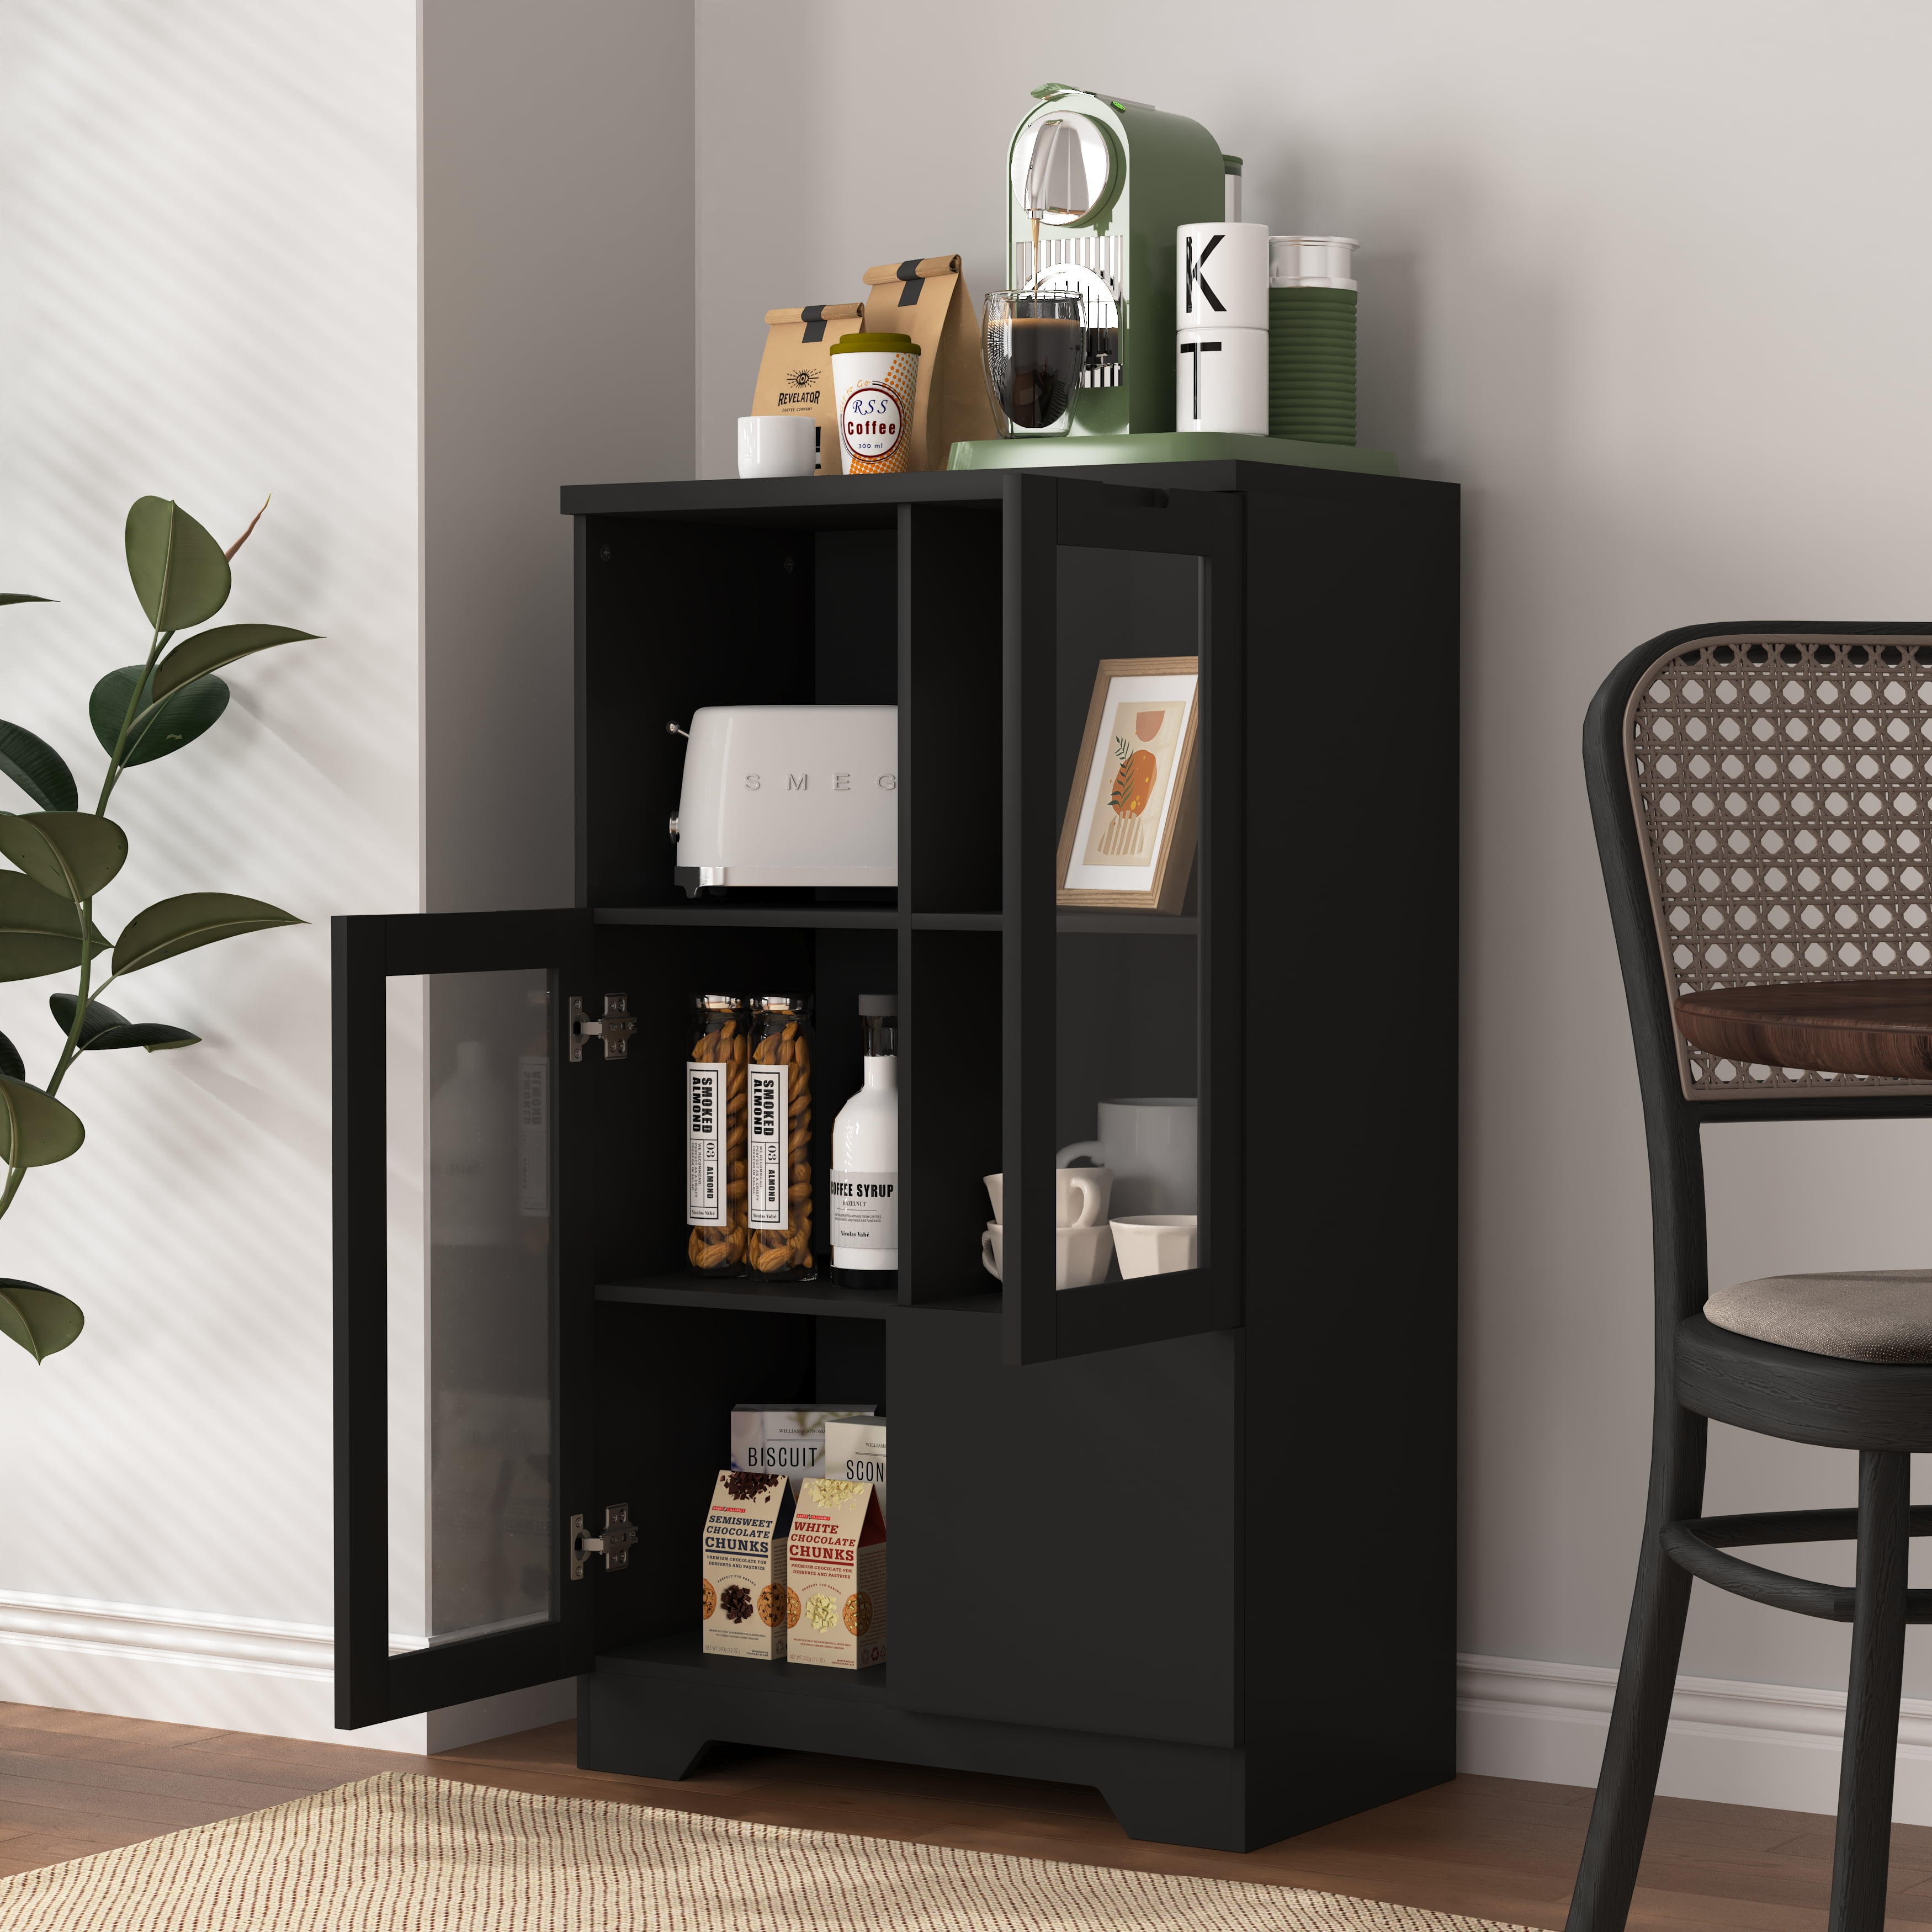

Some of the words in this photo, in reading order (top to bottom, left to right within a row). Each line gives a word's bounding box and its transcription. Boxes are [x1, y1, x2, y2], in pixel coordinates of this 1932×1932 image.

[1186, 235, 1227, 313] K
[1180, 342, 1222, 420] T
[778, 390, 820, 406] REVELATOR
[852, 400, 888, 416] RSS
[847, 421, 895, 435] Coffee
[745, 773, 896, 791] SMEG
[693, 1076, 701, 1132] ALMOND
[702, 1078, 713, 1133] SMOKED
[754, 1079, 762, 1135] ALMOND
[763, 1080, 774, 1135] SMOKED
[706, 1143, 715, 1158] 03
[759, 1145, 763, 1154] WE
[768, 1145, 777, 1161] 03
[831, 1181, 852, 1197] COFFEE
[857, 1183, 894, 1197] SYRUP
[749, 1447, 817, 1467] BISCUIT
[846, 1459, 884, 1483] SCON
[709, 1515, 773, 1528] SEMISWEET
[794, 1521, 839, 1534] WHITE
[707, 1526, 770, 1538] CHOCOLATE
[790, 1533, 856, 1547] CHOCOLATE
[705, 1536, 768, 1553] CHUNKS
[789, 1544, 854, 1561] CHUNKS
[717, 1575, 733, 1583] PERFECT
[742, 1577, 756, 1586] BAKING
[802, 1583, 818, 1592] PERFECT
[827, 1584, 842, 1595] BAKING
